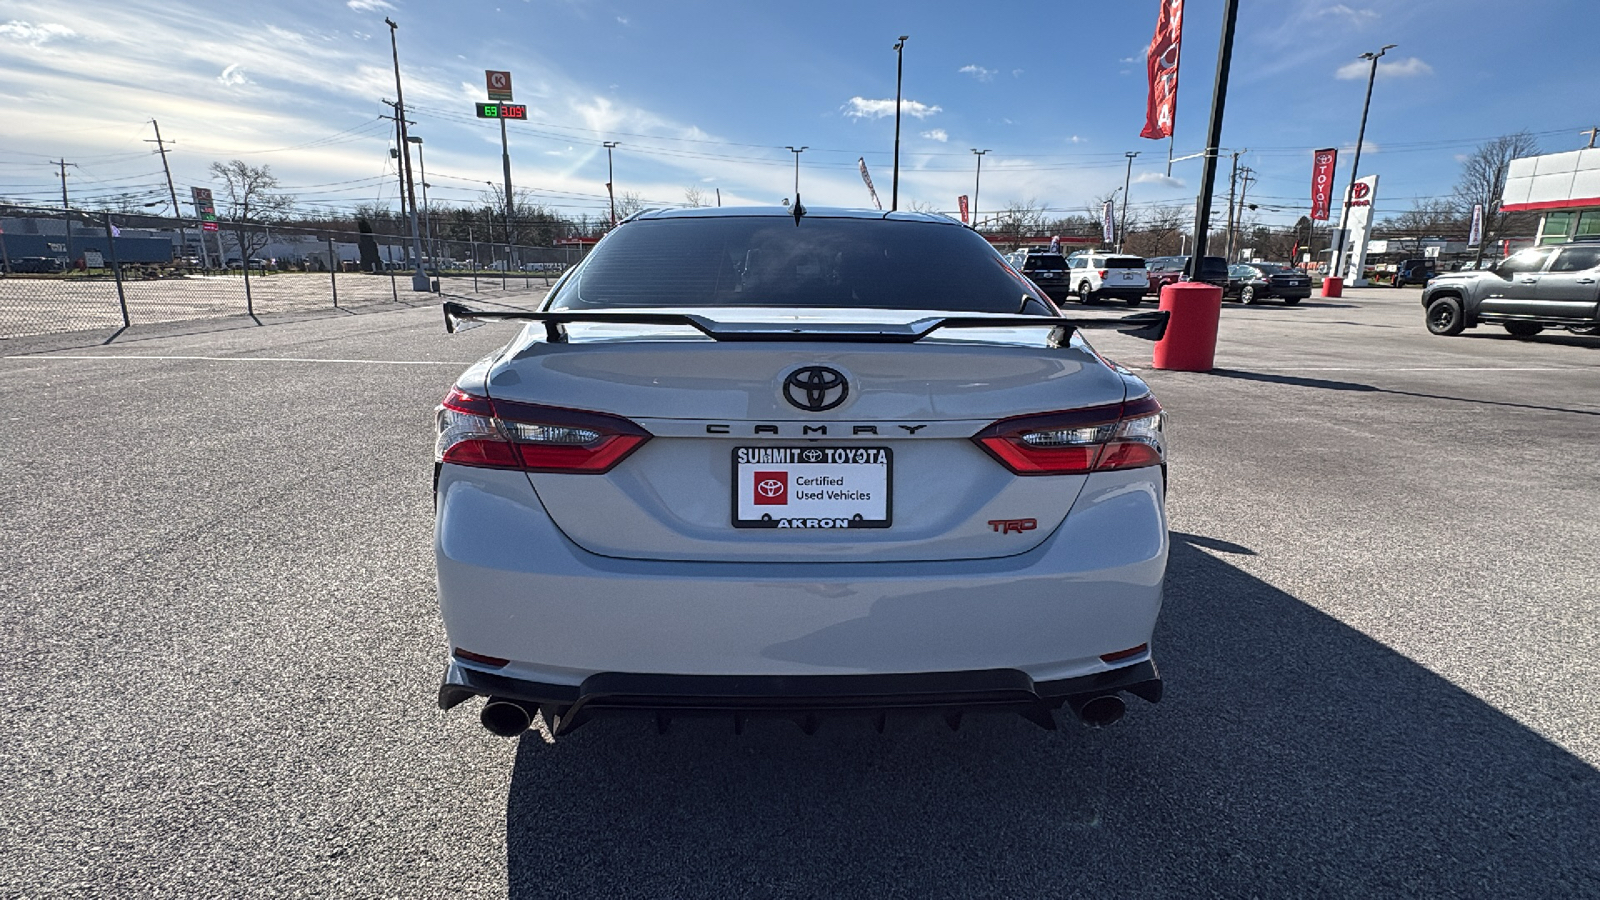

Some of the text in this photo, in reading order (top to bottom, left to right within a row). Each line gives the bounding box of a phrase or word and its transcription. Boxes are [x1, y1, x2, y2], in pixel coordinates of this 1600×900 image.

[484, 106, 498, 117] 69
[1315, 165, 1327, 217] TOYOTA
[706, 424, 927, 435] CAMRY
[738, 448, 887, 464] SUMMIT TOYOTA
[796, 476, 844, 486] Certified
[796, 490, 871, 500] Used Vehicles
[778, 518, 849, 528] AKRON
[988, 518, 1037, 534] TRD
